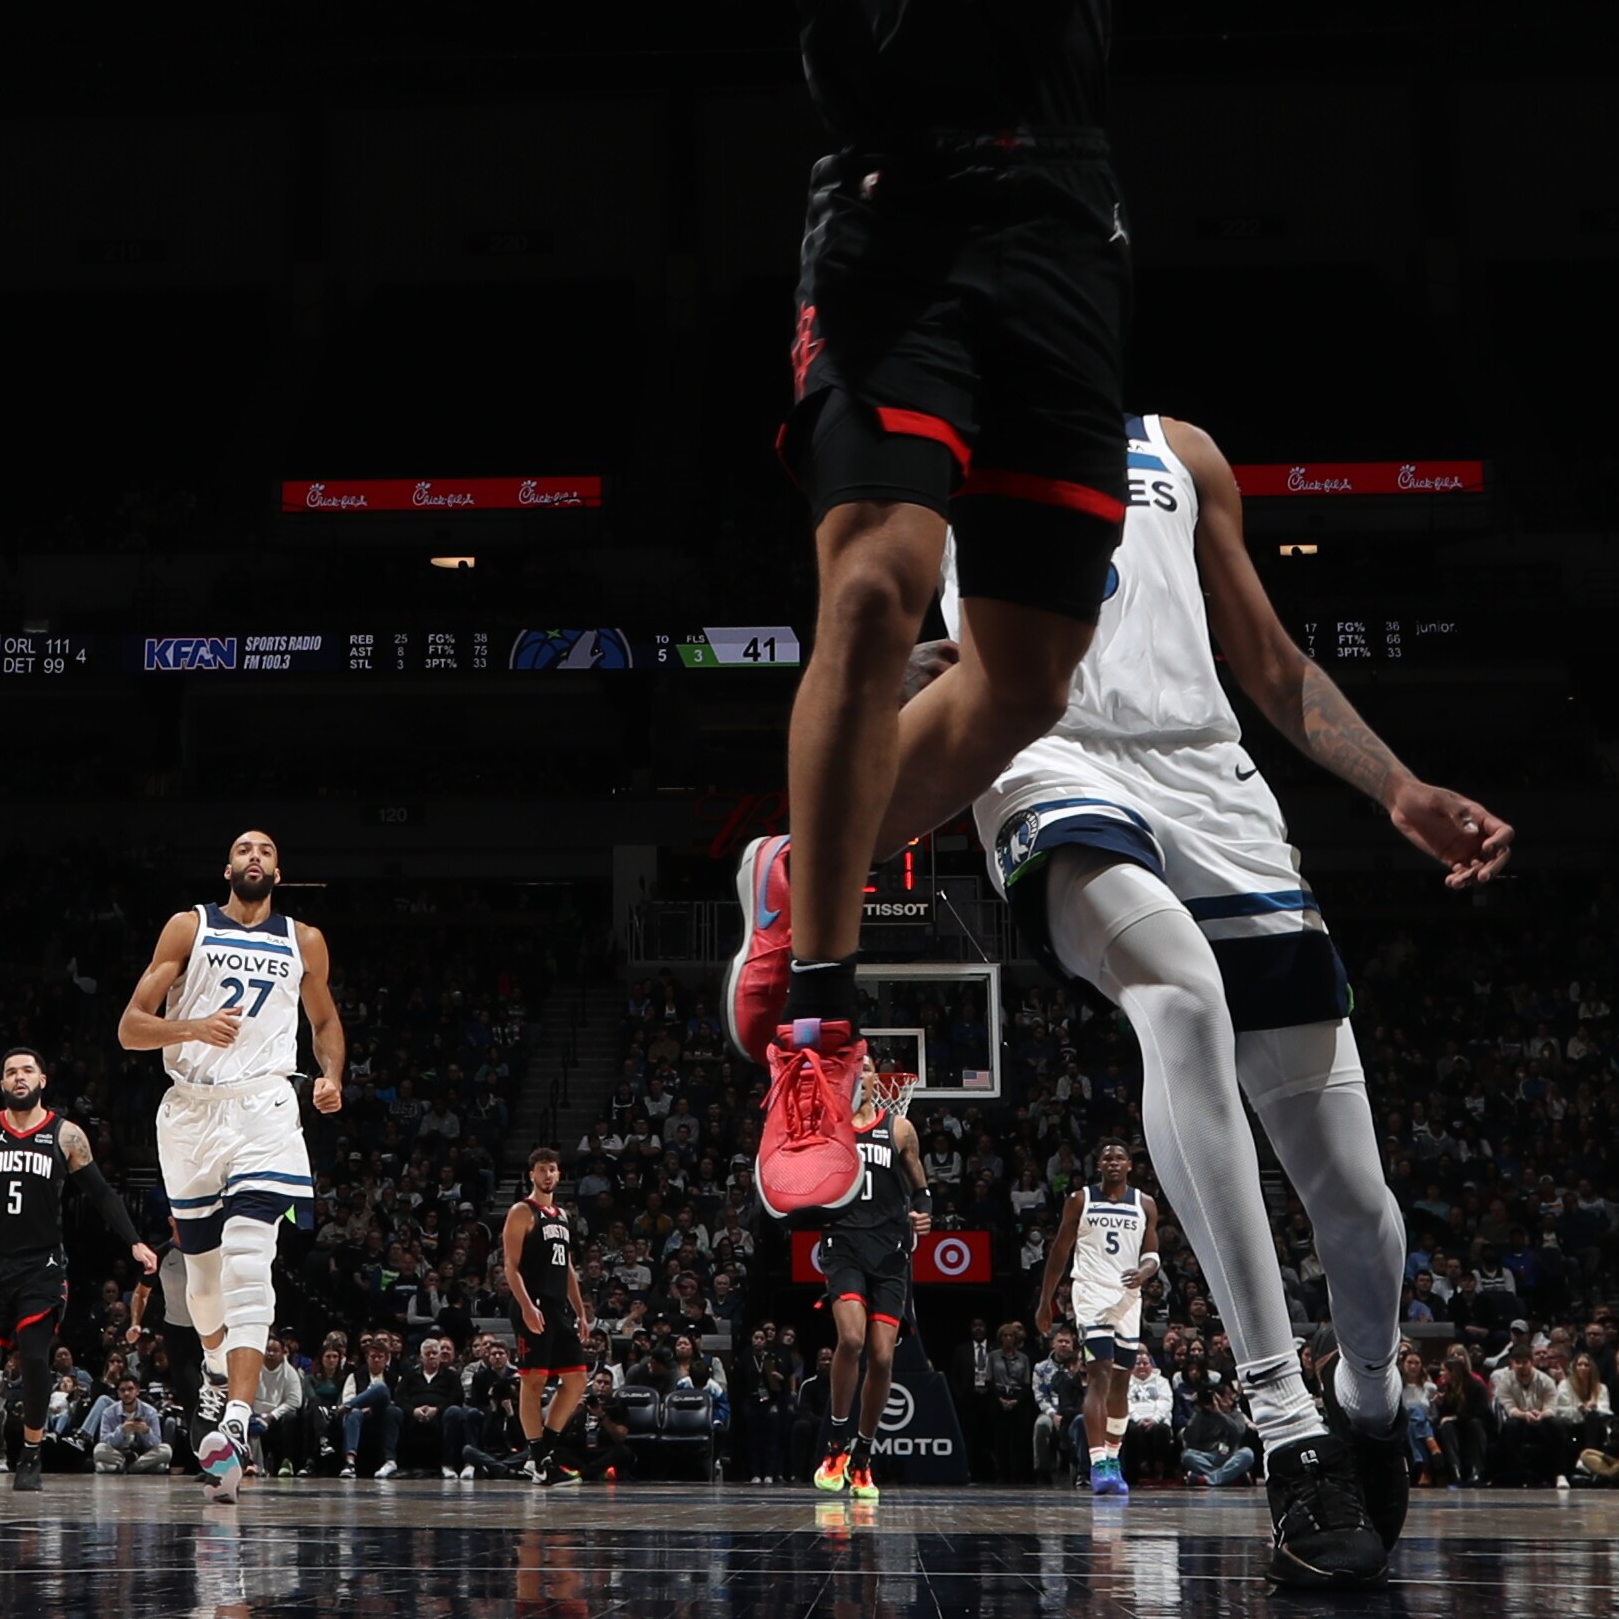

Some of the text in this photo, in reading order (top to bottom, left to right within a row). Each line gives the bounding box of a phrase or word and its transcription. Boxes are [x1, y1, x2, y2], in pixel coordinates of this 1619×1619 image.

[1304, 623, 1317, 633] 17
[1337, 621, 1365, 633] FG%
[1415, 620, 1458, 636] junior.
[245, 636, 323, 652] SPORTS RADIO
[350, 634, 408, 644] REB 25
[428, 633, 487, 644] FG% 38
[656, 635, 669, 644] TO
[686, 635, 705, 644] FLS
[1338, 634, 1365, 645] FT%
[1386, 633, 1401, 644] 66
[4, 638, 70, 654] ORL 111
[350, 647, 372, 656] AST
[428, 645, 487, 655] FT% 75
[743, 637, 777, 662] 41
[1337, 647, 1371, 658] 3PT%
[1387, 647, 1401, 658] 33
[76, 648, 86, 663] 4
[143, 637, 237, 670] KFAN
[658, 649, 667, 662] 5
[694, 649, 703, 662] 3
[3, 658, 64, 673] DET 99
[244, 654, 291, 670] FM 100.3
[350, 660, 404, 669] STL 3
[425, 658, 487, 668] 3PT% 33
[378, 806, 407, 822] 120
[863, 903, 929, 917] TISSOT
[205, 952, 288, 979] WOLVES
[218, 976, 274, 1018] 27
[855, 1142, 890, 1169] STON
[6, 1180, 21, 1215] 5
[1085, 1217, 1137, 1231] WOLVES
[1104, 1231, 1119, 1255] 5
[550, 1243, 566, 1266] 28
